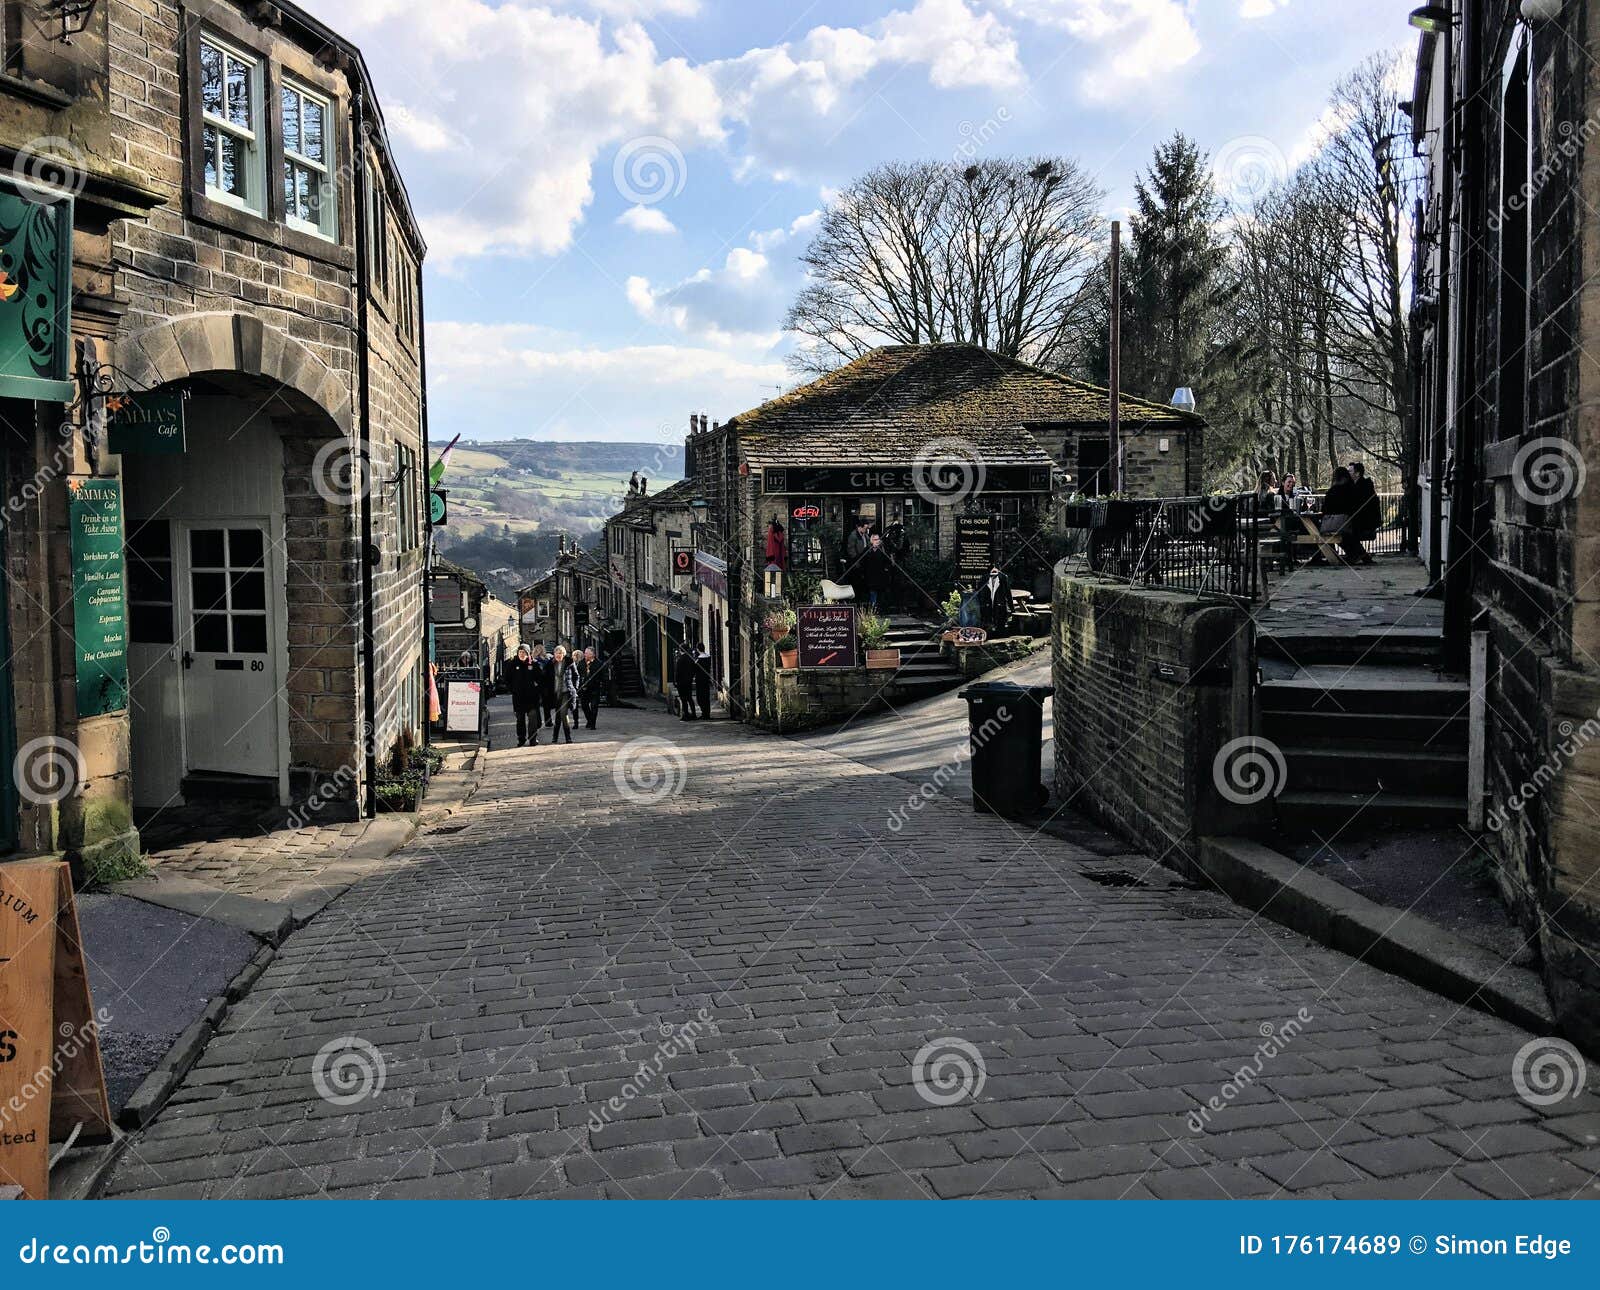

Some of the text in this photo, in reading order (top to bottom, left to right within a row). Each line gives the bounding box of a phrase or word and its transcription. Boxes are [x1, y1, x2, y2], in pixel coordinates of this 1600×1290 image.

[158, 424, 178, 437] Cafe
[850, 472, 895, 487] THE
[76, 489, 117, 500] EMMA'S
[104, 501, 117, 511] Cafe
[81, 514, 101, 523] Drink
[102, 514, 109, 522] in
[84, 524, 118, 535] Take Away
[83, 552, 108, 560] Yorkshire
[98, 615, 122, 625] Espresso
[103, 633, 122, 643] Mocha
[84, 648, 123, 661] Hot Chocolate
[250, 660, 264, 671] 80
